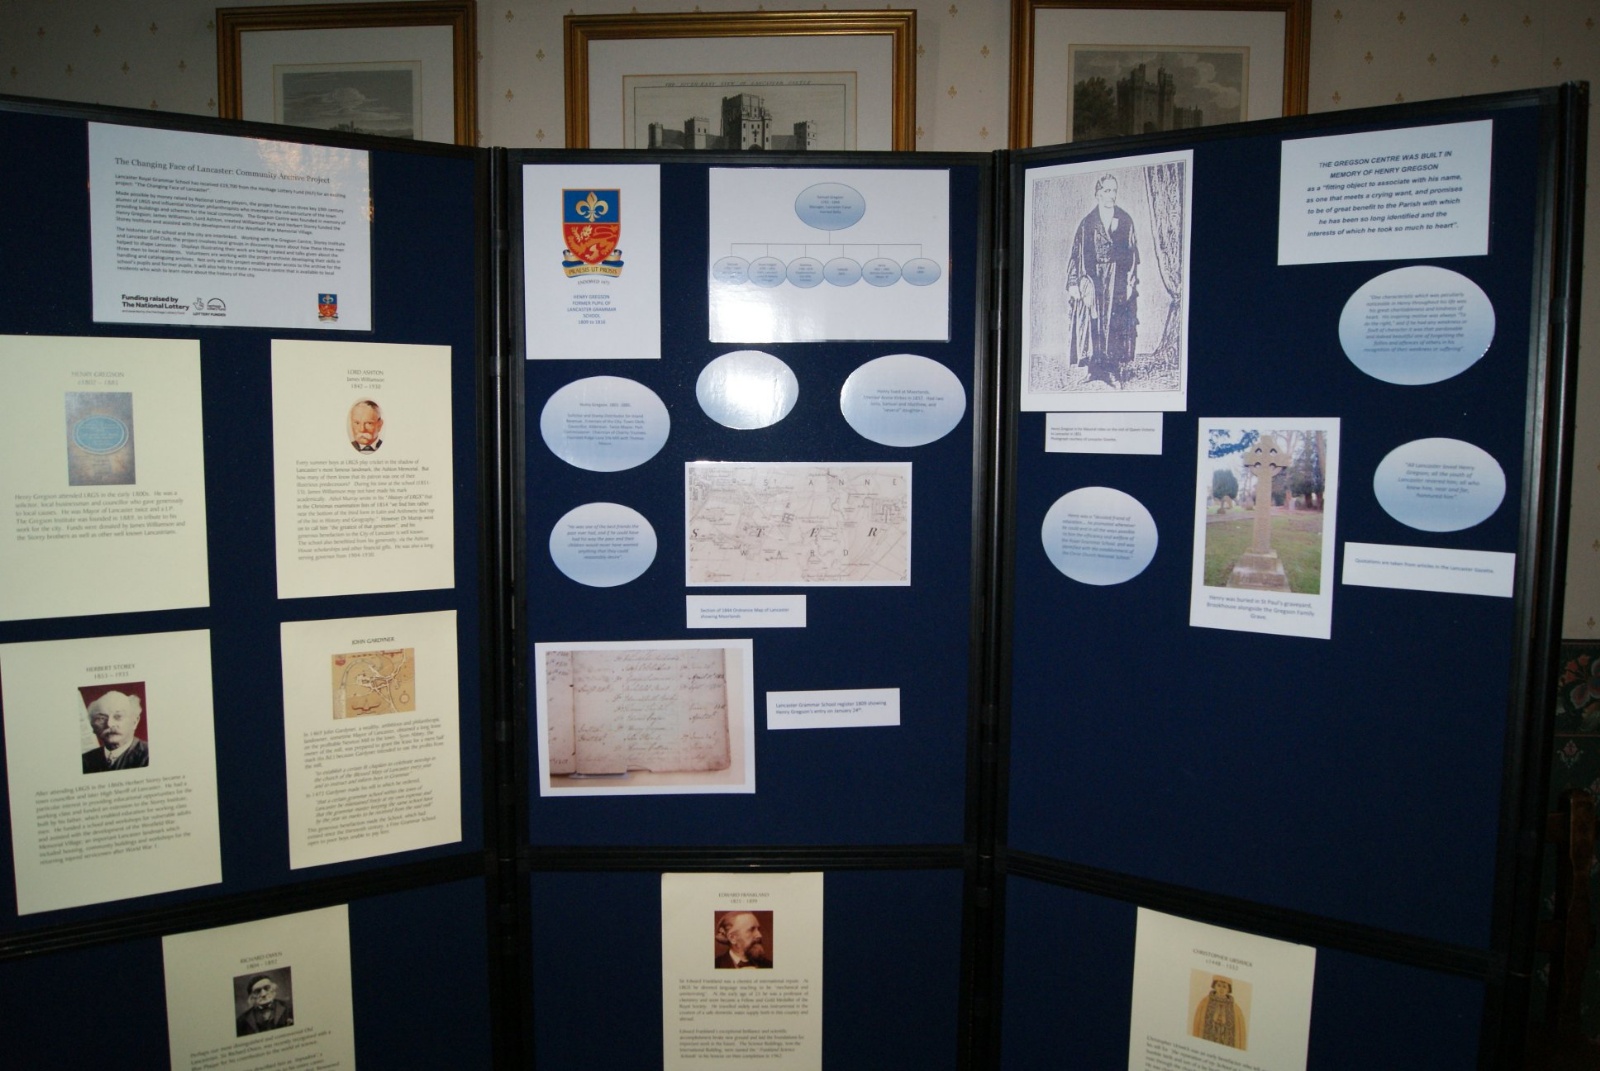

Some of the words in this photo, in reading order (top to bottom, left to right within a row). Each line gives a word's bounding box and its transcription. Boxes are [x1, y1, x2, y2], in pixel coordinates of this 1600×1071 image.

[1319, 160, 1332, 168] THE
[1334, 157, 1370, 167] GREGSON
[1371, 154, 1400, 164] CENTRE
[1402, 153, 1419, 161] WAS
[1421, 151, 1442, 160] BUILT
[115, 157, 130, 166] The
[131, 159, 167, 172] Changing
[169, 162, 186, 171] Face
[188, 163, 195, 172] of
[197, 164, 234, 175] Lancaster:
[235, 167, 277, 181] Community
[306, 174, 330, 185] Project
[1330, 169, 1361, 178] MEMORY
[1374, 166, 1399, 175] HENRY
[1401, 163, 1439, 173] GREGSON
[1346, 180, 1367, 191] object
[1377, 177, 1410, 186] associate
[1411, 176, 1426, 184] with
[1329, 193, 1342, 201] that
[1343, 192, 1363, 200] meets
[1371, 190, 1393, 200] crying
[1414, 187, 1428, 195] and
[1429, 186, 1463, 196] promises
[1333, 204, 1351, 214] great
[1352, 202, 1375, 211] benefit
[1398, 199, 1420, 208] Parish
[1439, 197, 1460, 205] which
[1342, 215, 1358, 223] been
[1369, 213, 1385, 223] long
[1386, 211, 1419, 220] identified
[1307, 228, 1335, 237] interests
[1345, 226, 1365, 235] which
[1404, 223, 1424, 231] much
[122, 294, 148, 303] Funding
[170, 295, 178, 304] by
[165, 303, 190, 311] Lottery
